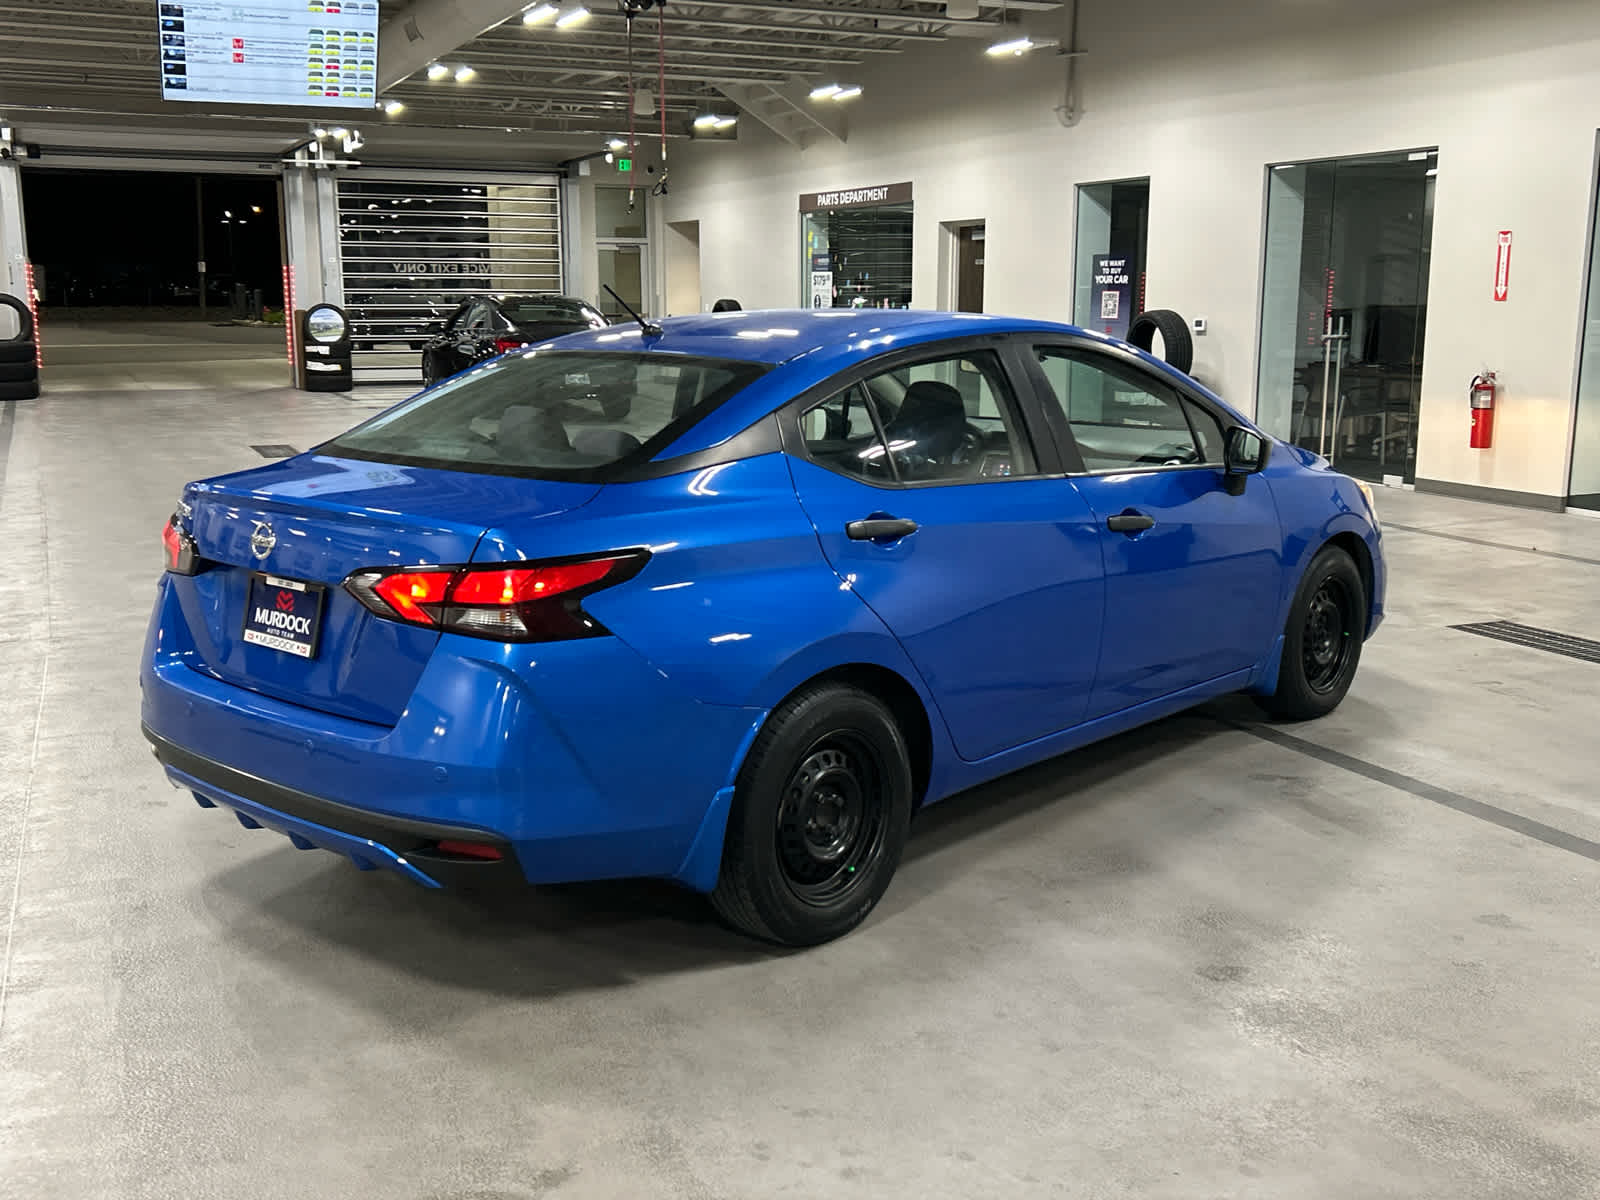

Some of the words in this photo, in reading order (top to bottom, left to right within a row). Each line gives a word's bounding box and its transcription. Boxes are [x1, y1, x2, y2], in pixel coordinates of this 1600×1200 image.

[817, 193, 839, 206] PARTS
[840, 187, 888, 205] DEPARTMENT
[1110, 259, 1126, 267] WANT
[1095, 275, 1113, 284] YOUR
[1114, 275, 1129, 284] CAR
[254, 607, 311, 635] MURDOCK
[266, 628, 280, 637] AUTO
[281, 631, 295, 639] TEAM
